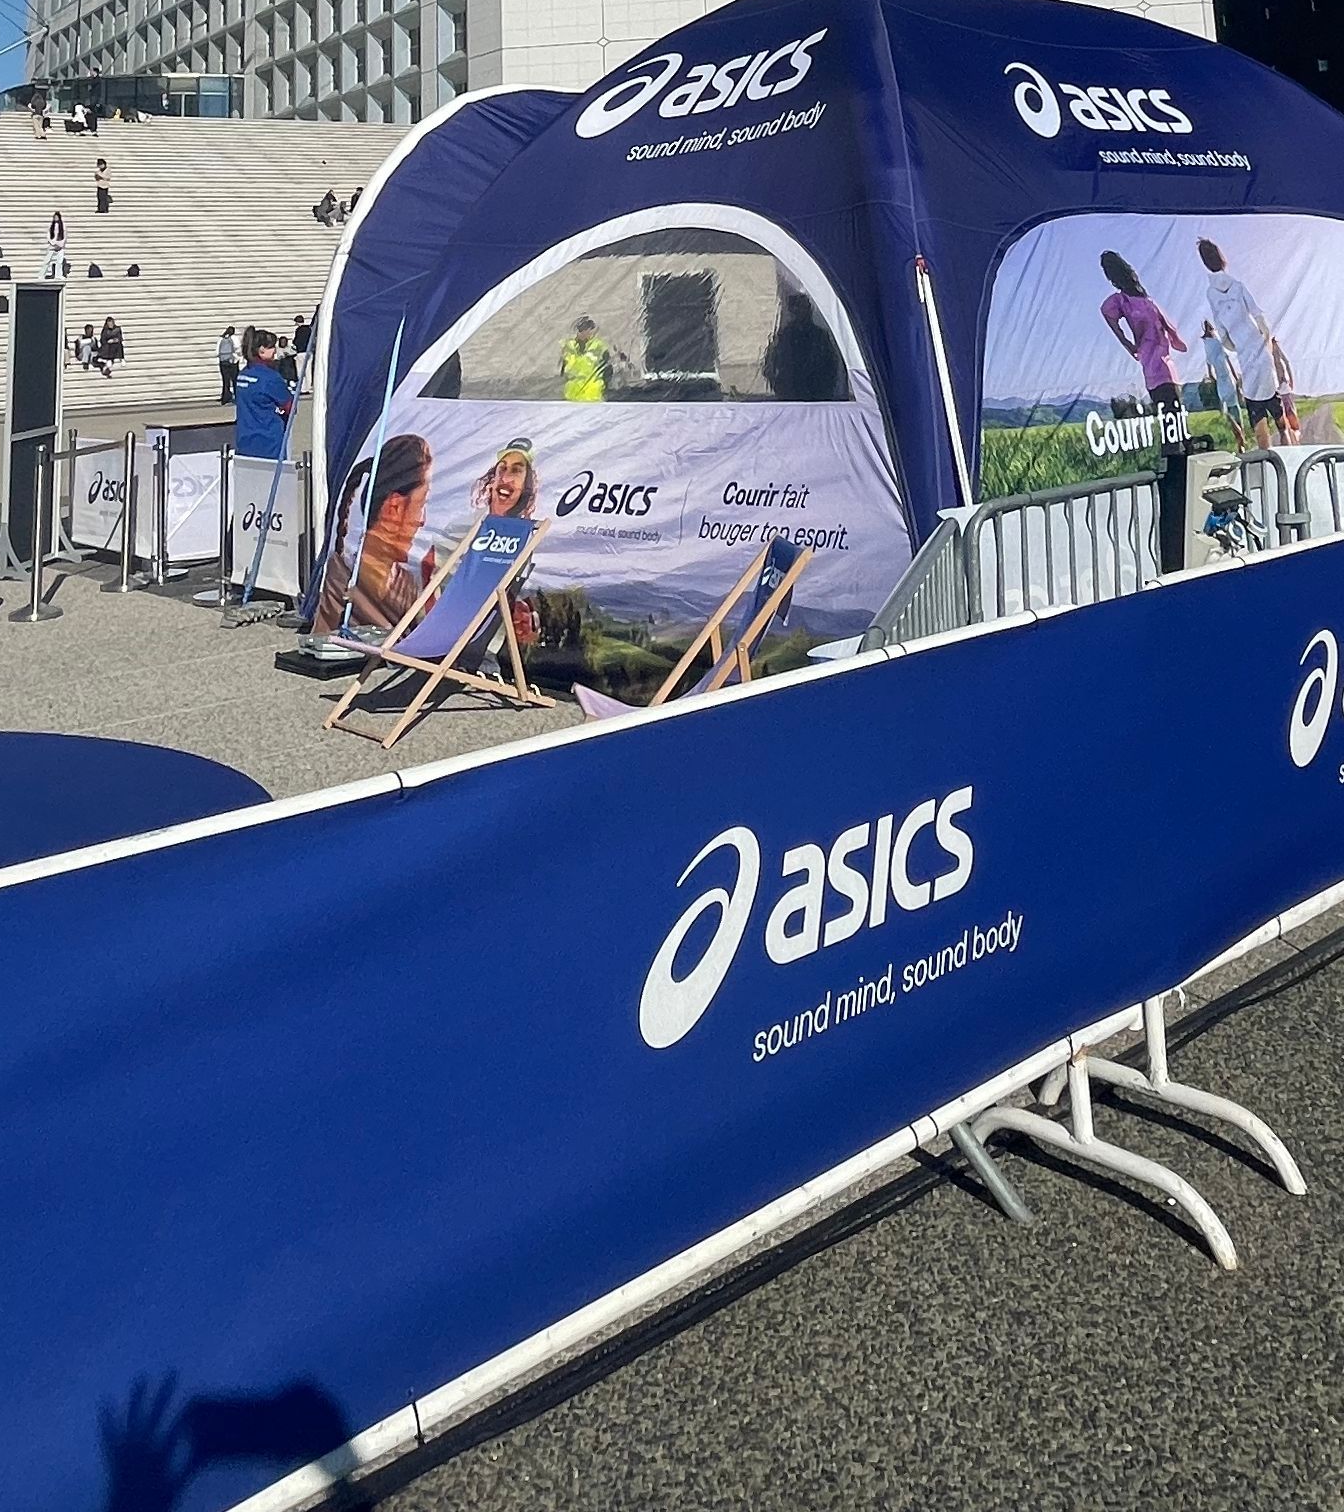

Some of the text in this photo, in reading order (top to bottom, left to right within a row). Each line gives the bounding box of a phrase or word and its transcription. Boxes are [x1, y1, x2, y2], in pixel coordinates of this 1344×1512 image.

[658, 28, 828, 118] asics
[626, 100, 827, 162] sound mind, sound body
[1058, 82, 1193, 134] asics
[1098, 147, 1251, 171] sound mind, sound body
[1086, 400, 1192, 457] Courir fait
[588, 482, 659, 517] asics
[722, 481, 810, 509] Courir fait
[490, 535, 521, 554] asics
[698, 515, 758, 548] bouger
[794, 524, 850, 552] esprit.
[764, 785, 975, 965] asics
[752, 909, 1024, 1063] sound mind, sound body
